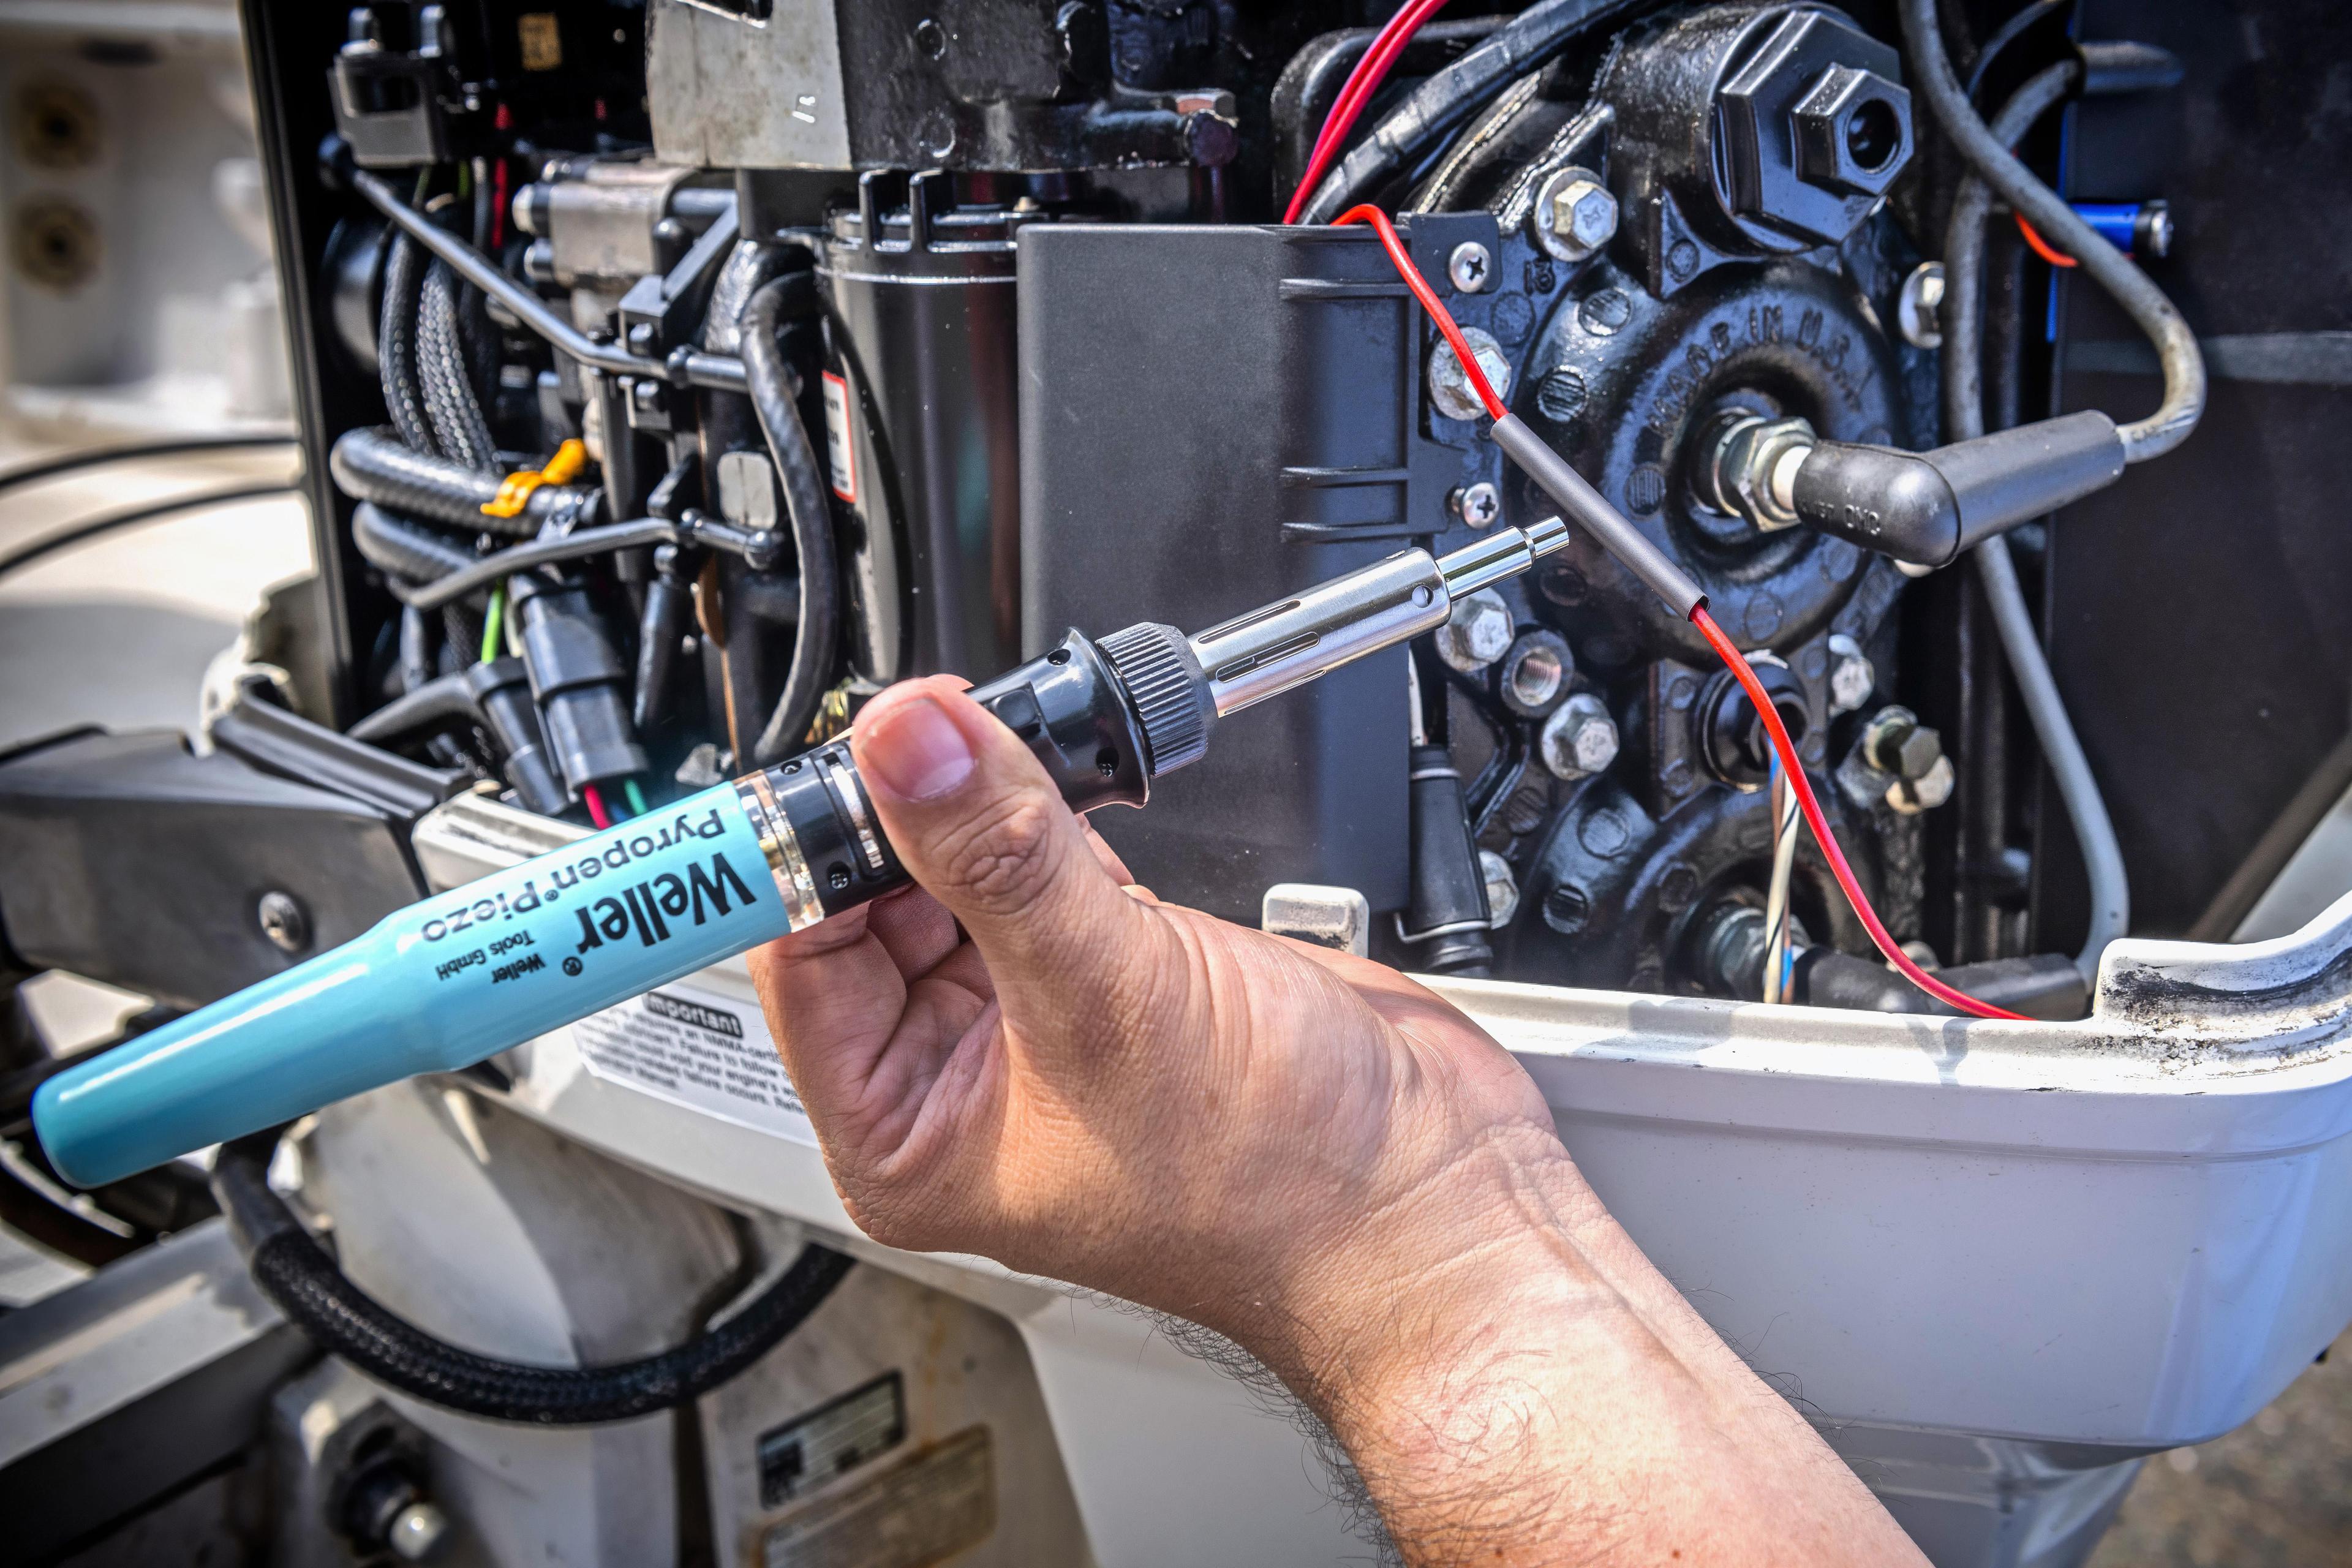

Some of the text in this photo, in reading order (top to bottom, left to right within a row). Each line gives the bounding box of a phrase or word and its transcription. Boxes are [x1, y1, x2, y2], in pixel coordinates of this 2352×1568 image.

[1750, 305, 1784, 343] IN
[421, 809, 726, 942] Pyropen Piezo
[575, 852, 756, 954] Weller
[435, 930, 535, 981] Tools GmbH
[492, 953, 546, 984] Weller
[645, 994, 741, 1036] mportant
[739, 1057, 778, 1078] follow
